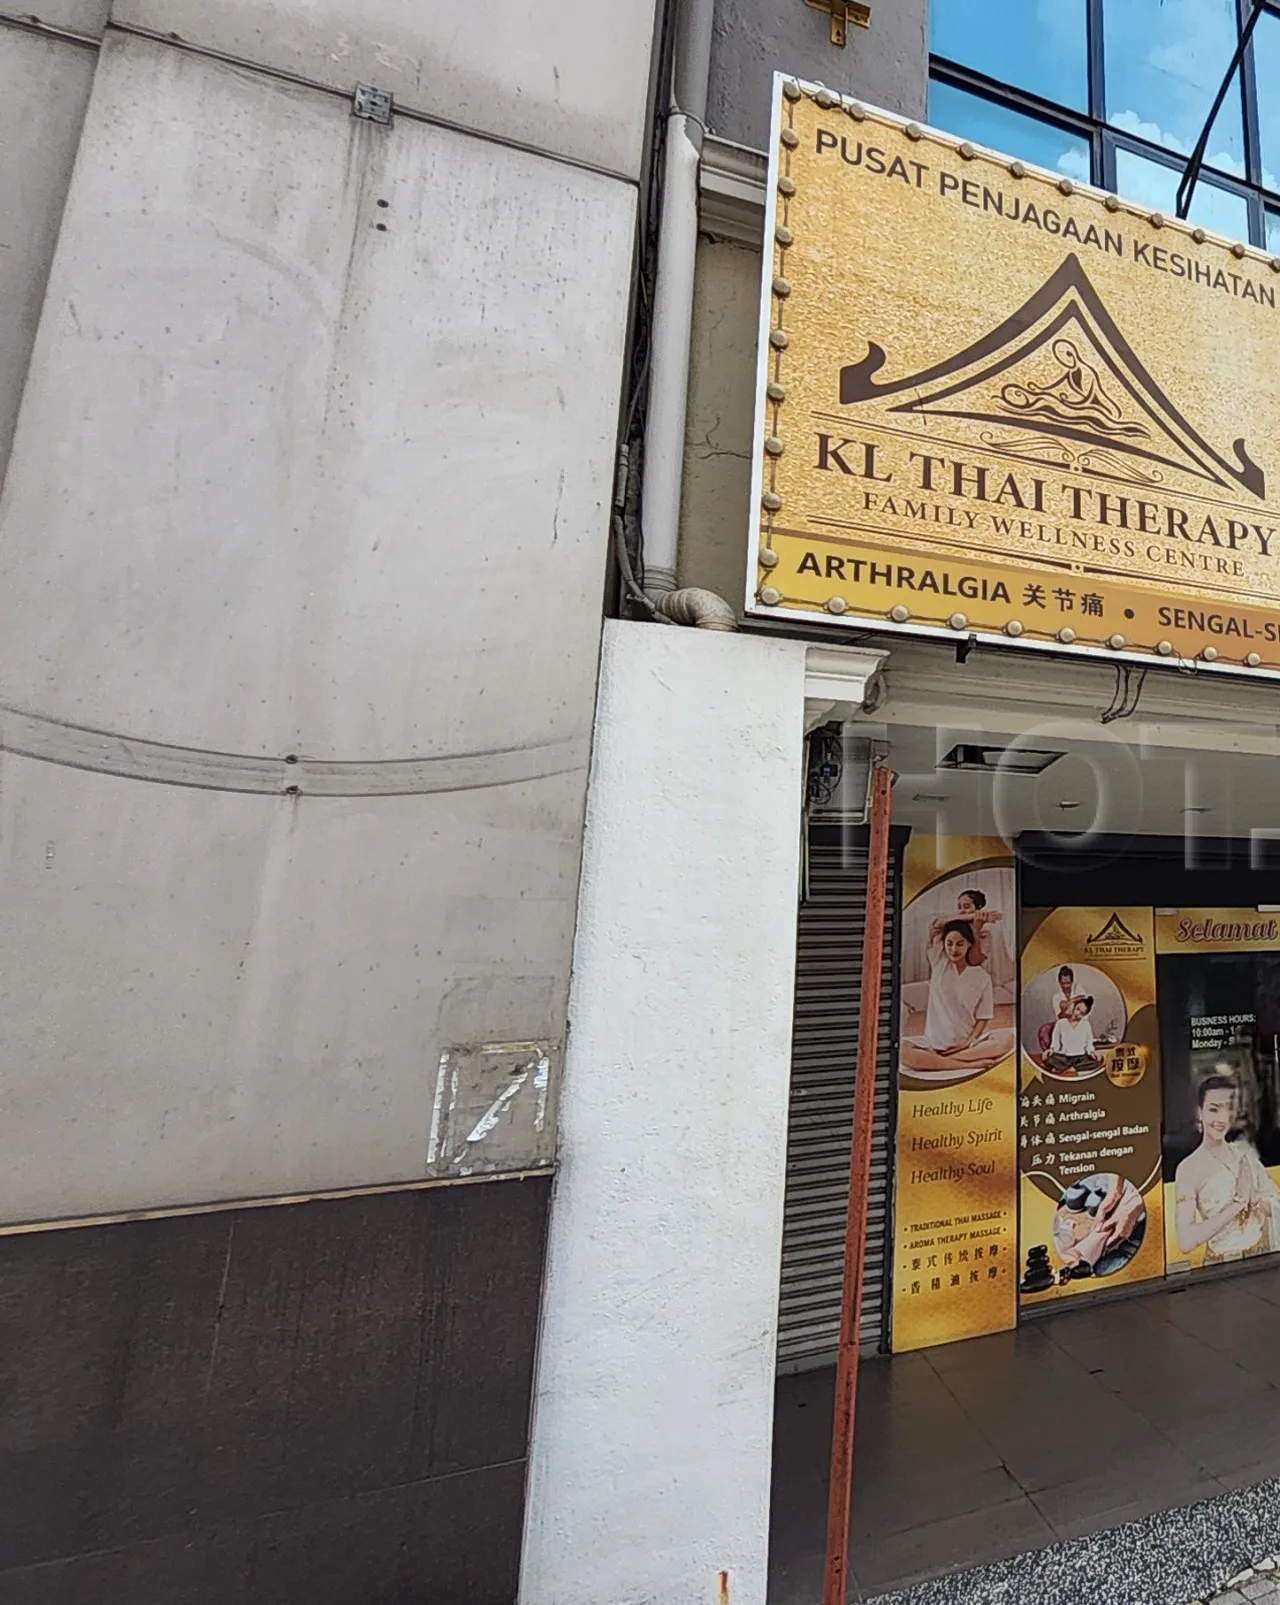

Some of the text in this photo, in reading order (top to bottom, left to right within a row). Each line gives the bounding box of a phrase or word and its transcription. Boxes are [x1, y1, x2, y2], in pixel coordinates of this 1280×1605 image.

[815, 128, 1276, 309] PUSAT PENJAGAAN KESIHATAN
[813, 433, 1277, 557] KL THAI THERAPY
[863, 491, 1244, 578] FAMILY WELLNESS CENTRE
[796, 551, 1011, 603] ARTHRALGIA
[1022, 582, 1105, 618] 关节痛
[1176, 918, 1278, 942] Selamat
[1191, 1014, 1256, 1027] BUSINESS HOURS:
[1191, 1028, 1224, 1038] 10:00am
[1192, 1038, 1223, 1050] Monday
[1059, 1092, 1095, 1105] Migrain
[912, 1098, 993, 1118] Healthy Life
[1059, 1109, 1106, 1123] Arthralgia
[911, 1128, 1002, 1151] Healthy Spirit
[1059, 1128, 1121, 1144] Sengal-sengal
[1122, 1125, 1149, 1135] Badan
[1059, 1150, 1097, 1162] Tekanan
[1100, 1146, 1133, 1159] dengan
[911, 1160, 995, 1184] Healthy Soul
[1059, 1163, 1095, 1176] Tension
[910, 1219, 952, 1233] TRADITIONAL
[954, 1216, 970, 1227] THAI
[909, 1238, 935, 1249] AROMA
[937, 1232, 968, 1245] THERAPY
